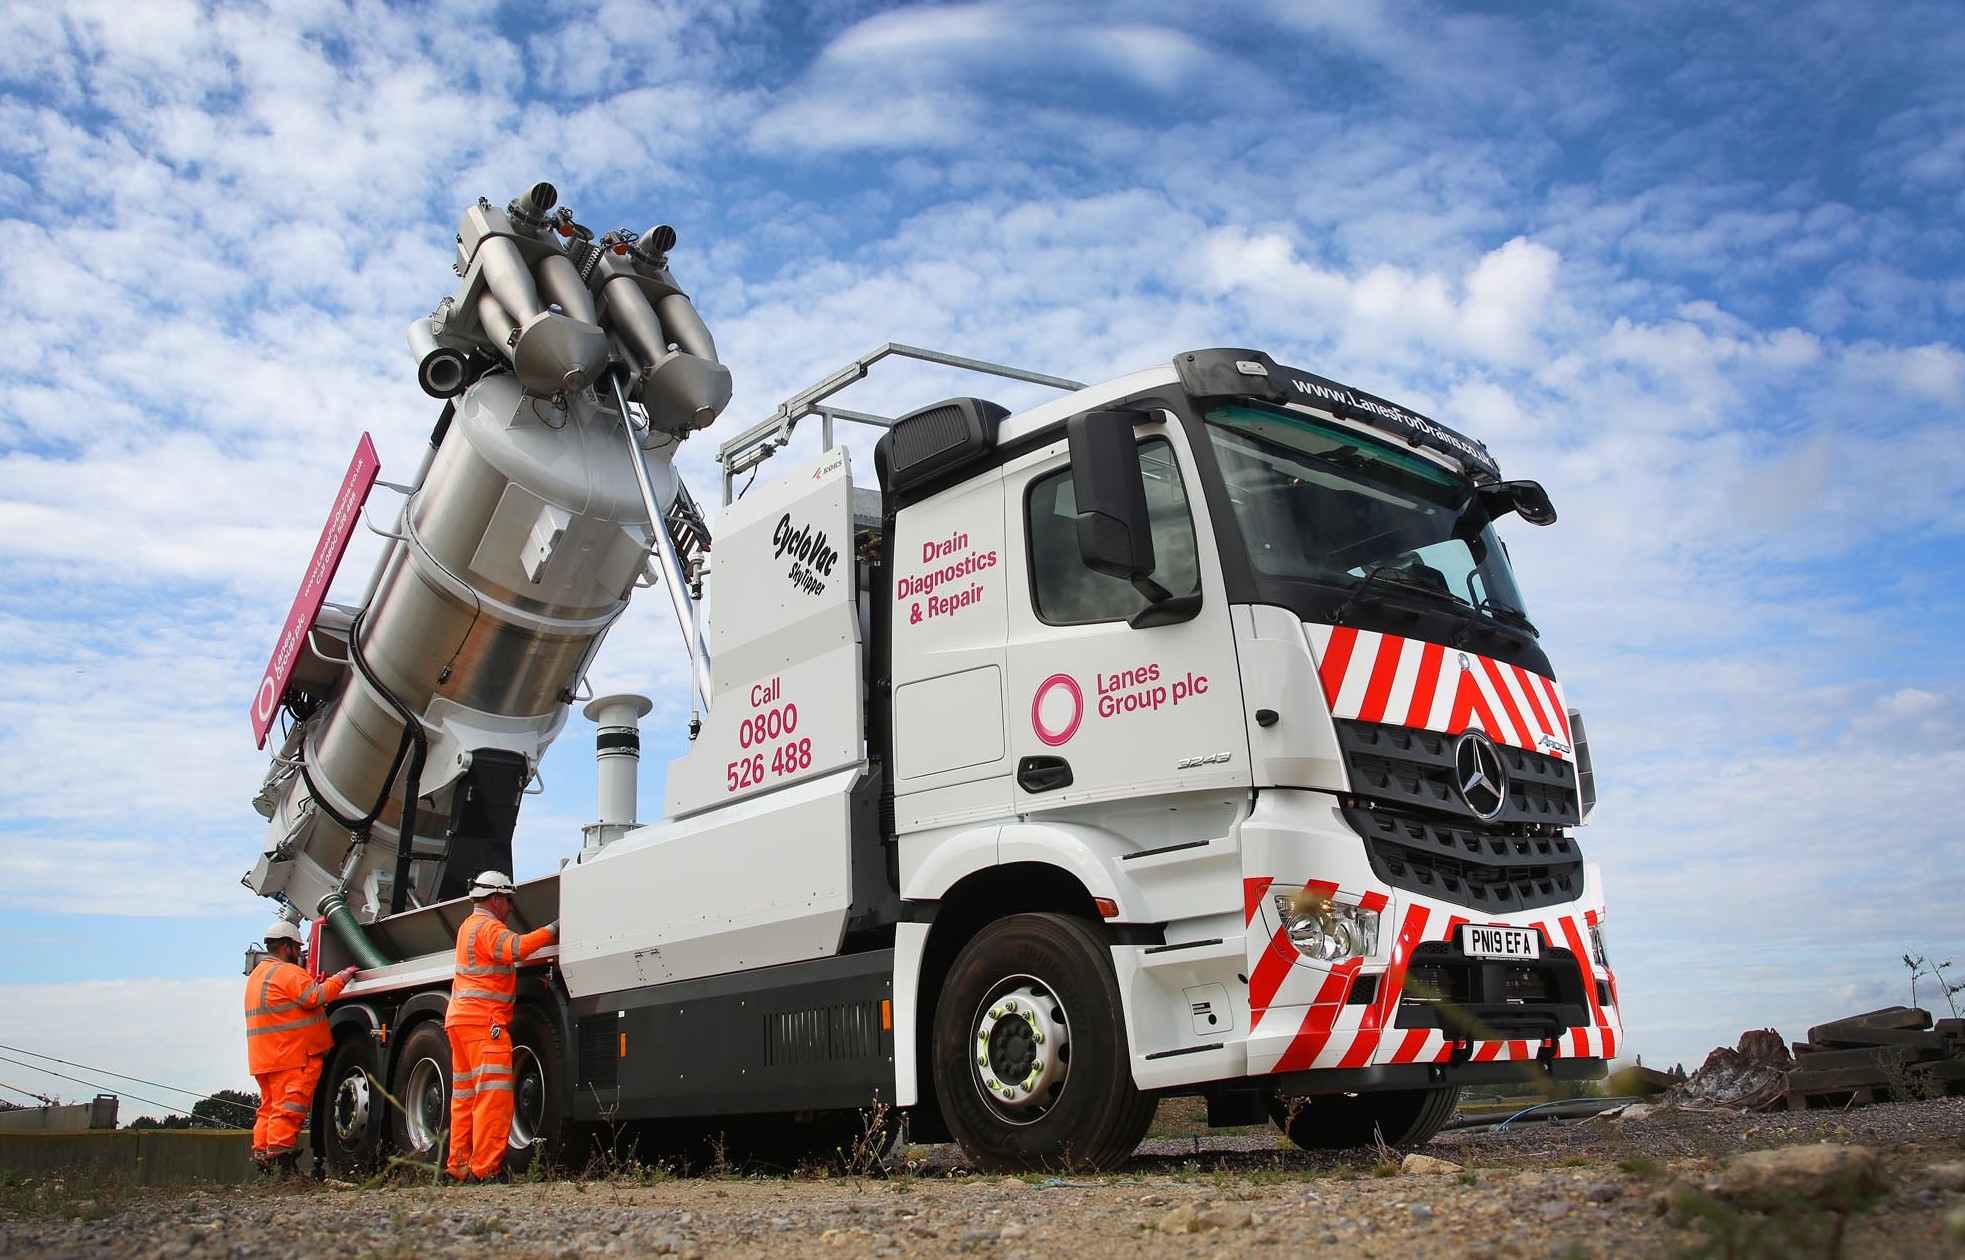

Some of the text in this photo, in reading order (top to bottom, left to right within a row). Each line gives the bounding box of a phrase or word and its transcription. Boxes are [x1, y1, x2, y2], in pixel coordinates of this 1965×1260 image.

[1292, 379, 1493, 468] www.LanesForDrains.co.uk
[316, 562, 326, 585] Call
[325, 534, 338, 564] 0800
[773, 512, 838, 577] CycloVac
[922, 531, 968, 564] Drain
[788, 561, 826, 596] SkyTipper
[897, 550, 997, 600] Diagnostics
[909, 582, 984, 625] & Repair
[274, 630, 292, 673] Lanes
[276, 613, 305, 681] Group plc
[751, 677, 780, 708] Call
[1097, 663, 1160, 695] Lanes
[1098, 672, 1209, 718] Group plc
[740, 703, 798, 749] 0800
[727, 737, 812, 792] 526 488
[1177, 751, 1232, 770] 3243
[1472, 929, 1531, 955] PN19 EFA
